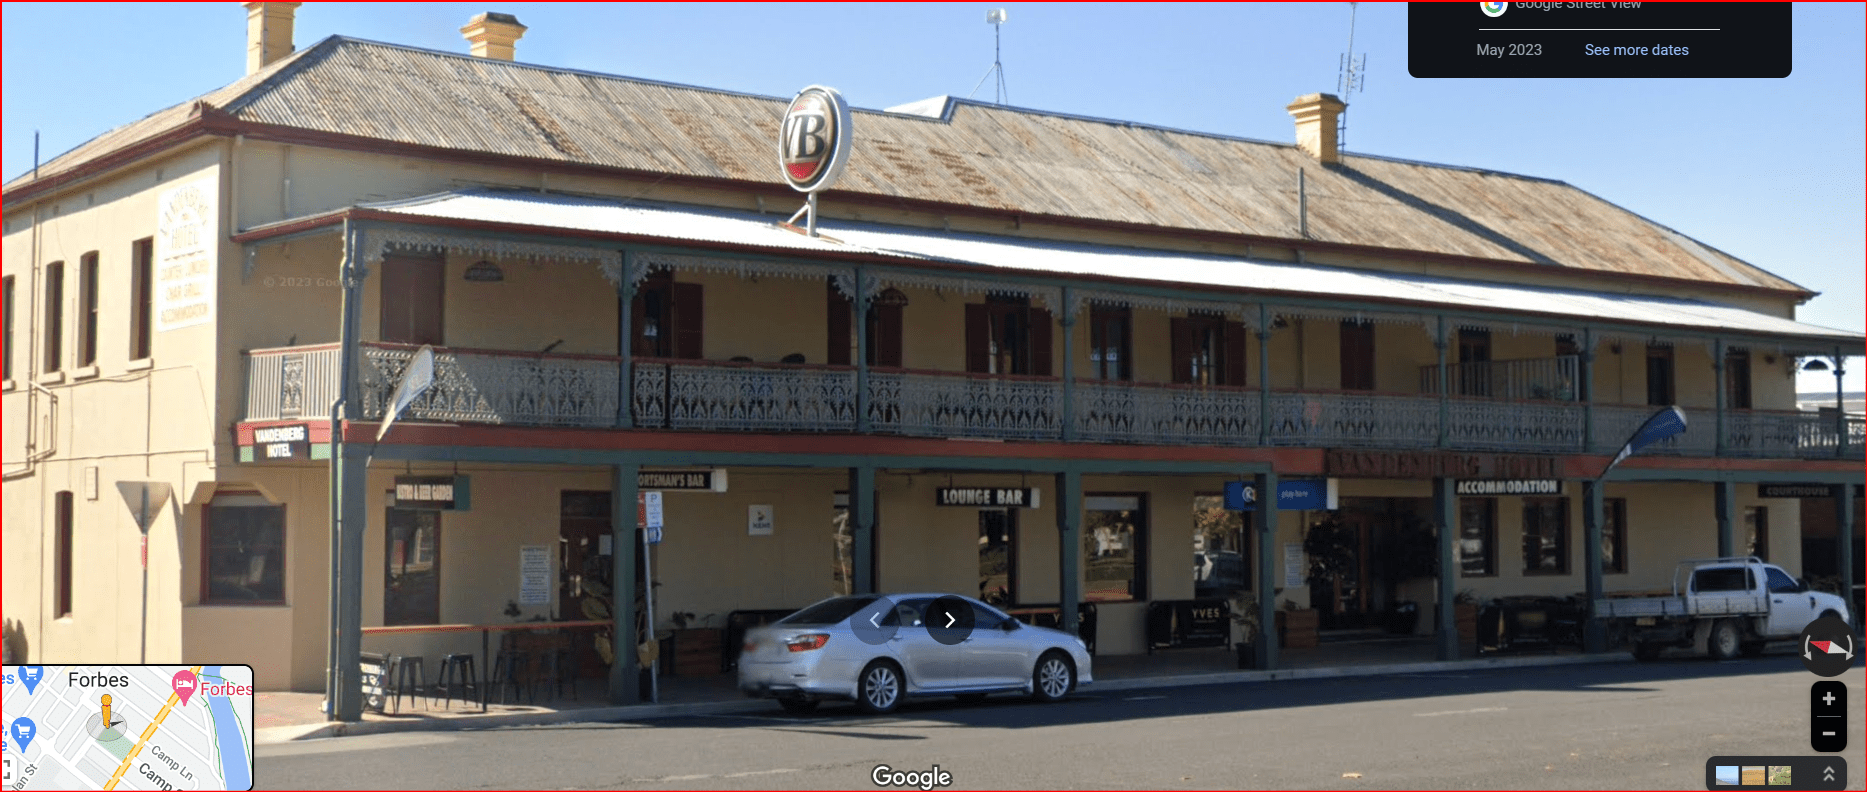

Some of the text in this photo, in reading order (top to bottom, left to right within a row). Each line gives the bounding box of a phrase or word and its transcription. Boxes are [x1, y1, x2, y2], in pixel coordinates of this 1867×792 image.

[783, 114, 826, 159] VB
[255, 426, 305, 443] VANDENBERG
[266, 443, 292, 458] HOTEL
[686, 473, 705, 487] BAR
[1457, 480, 1559, 495] ACCOMMODATION
[943, 489, 1023, 505] LOUNGE BAR
[1766, 487, 1830, 496] COURTHOUSE
[1191, 607, 1220, 619] YVES
